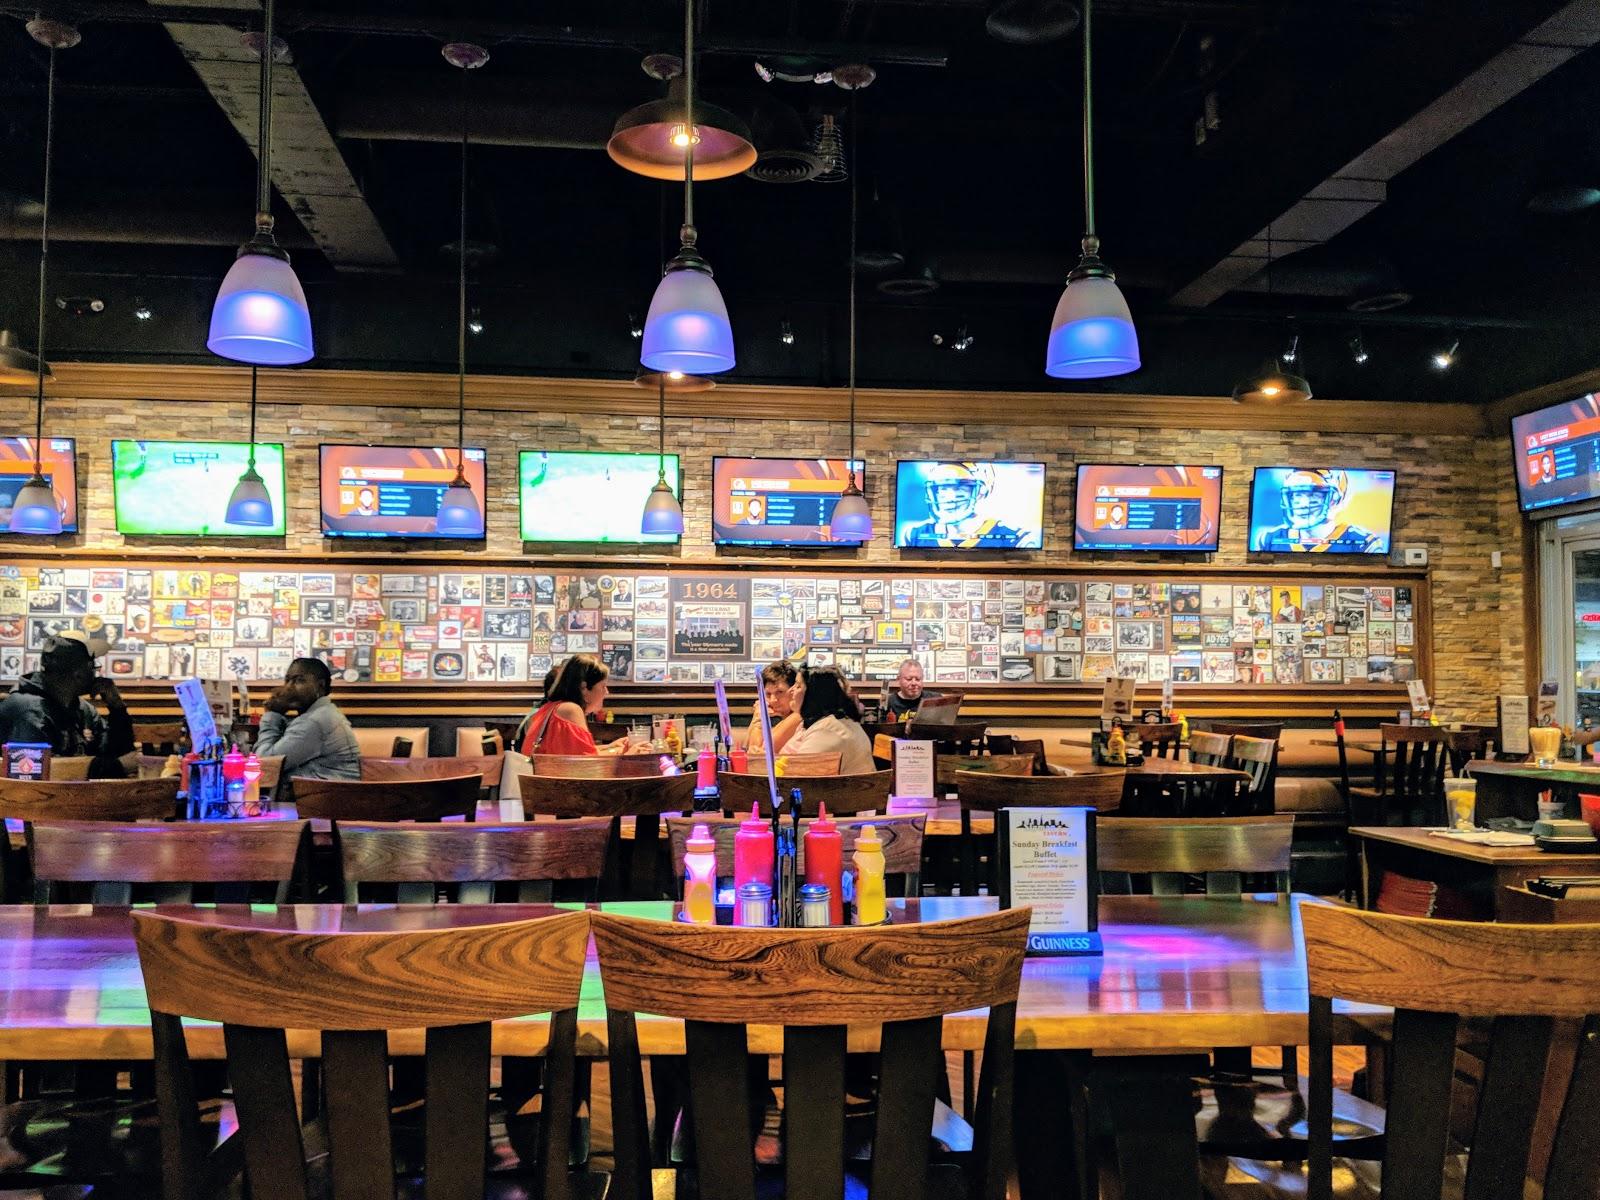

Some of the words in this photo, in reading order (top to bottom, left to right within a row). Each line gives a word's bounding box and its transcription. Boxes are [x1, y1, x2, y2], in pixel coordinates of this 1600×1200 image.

[683, 583, 738, 600] 1964
[1012, 840, 1039, 850] Sunday
[1042, 839, 1078, 848] Breakfast
[1034, 850, 1057, 859] Buffet
[1031, 935, 1090, 950] GUINNESS
